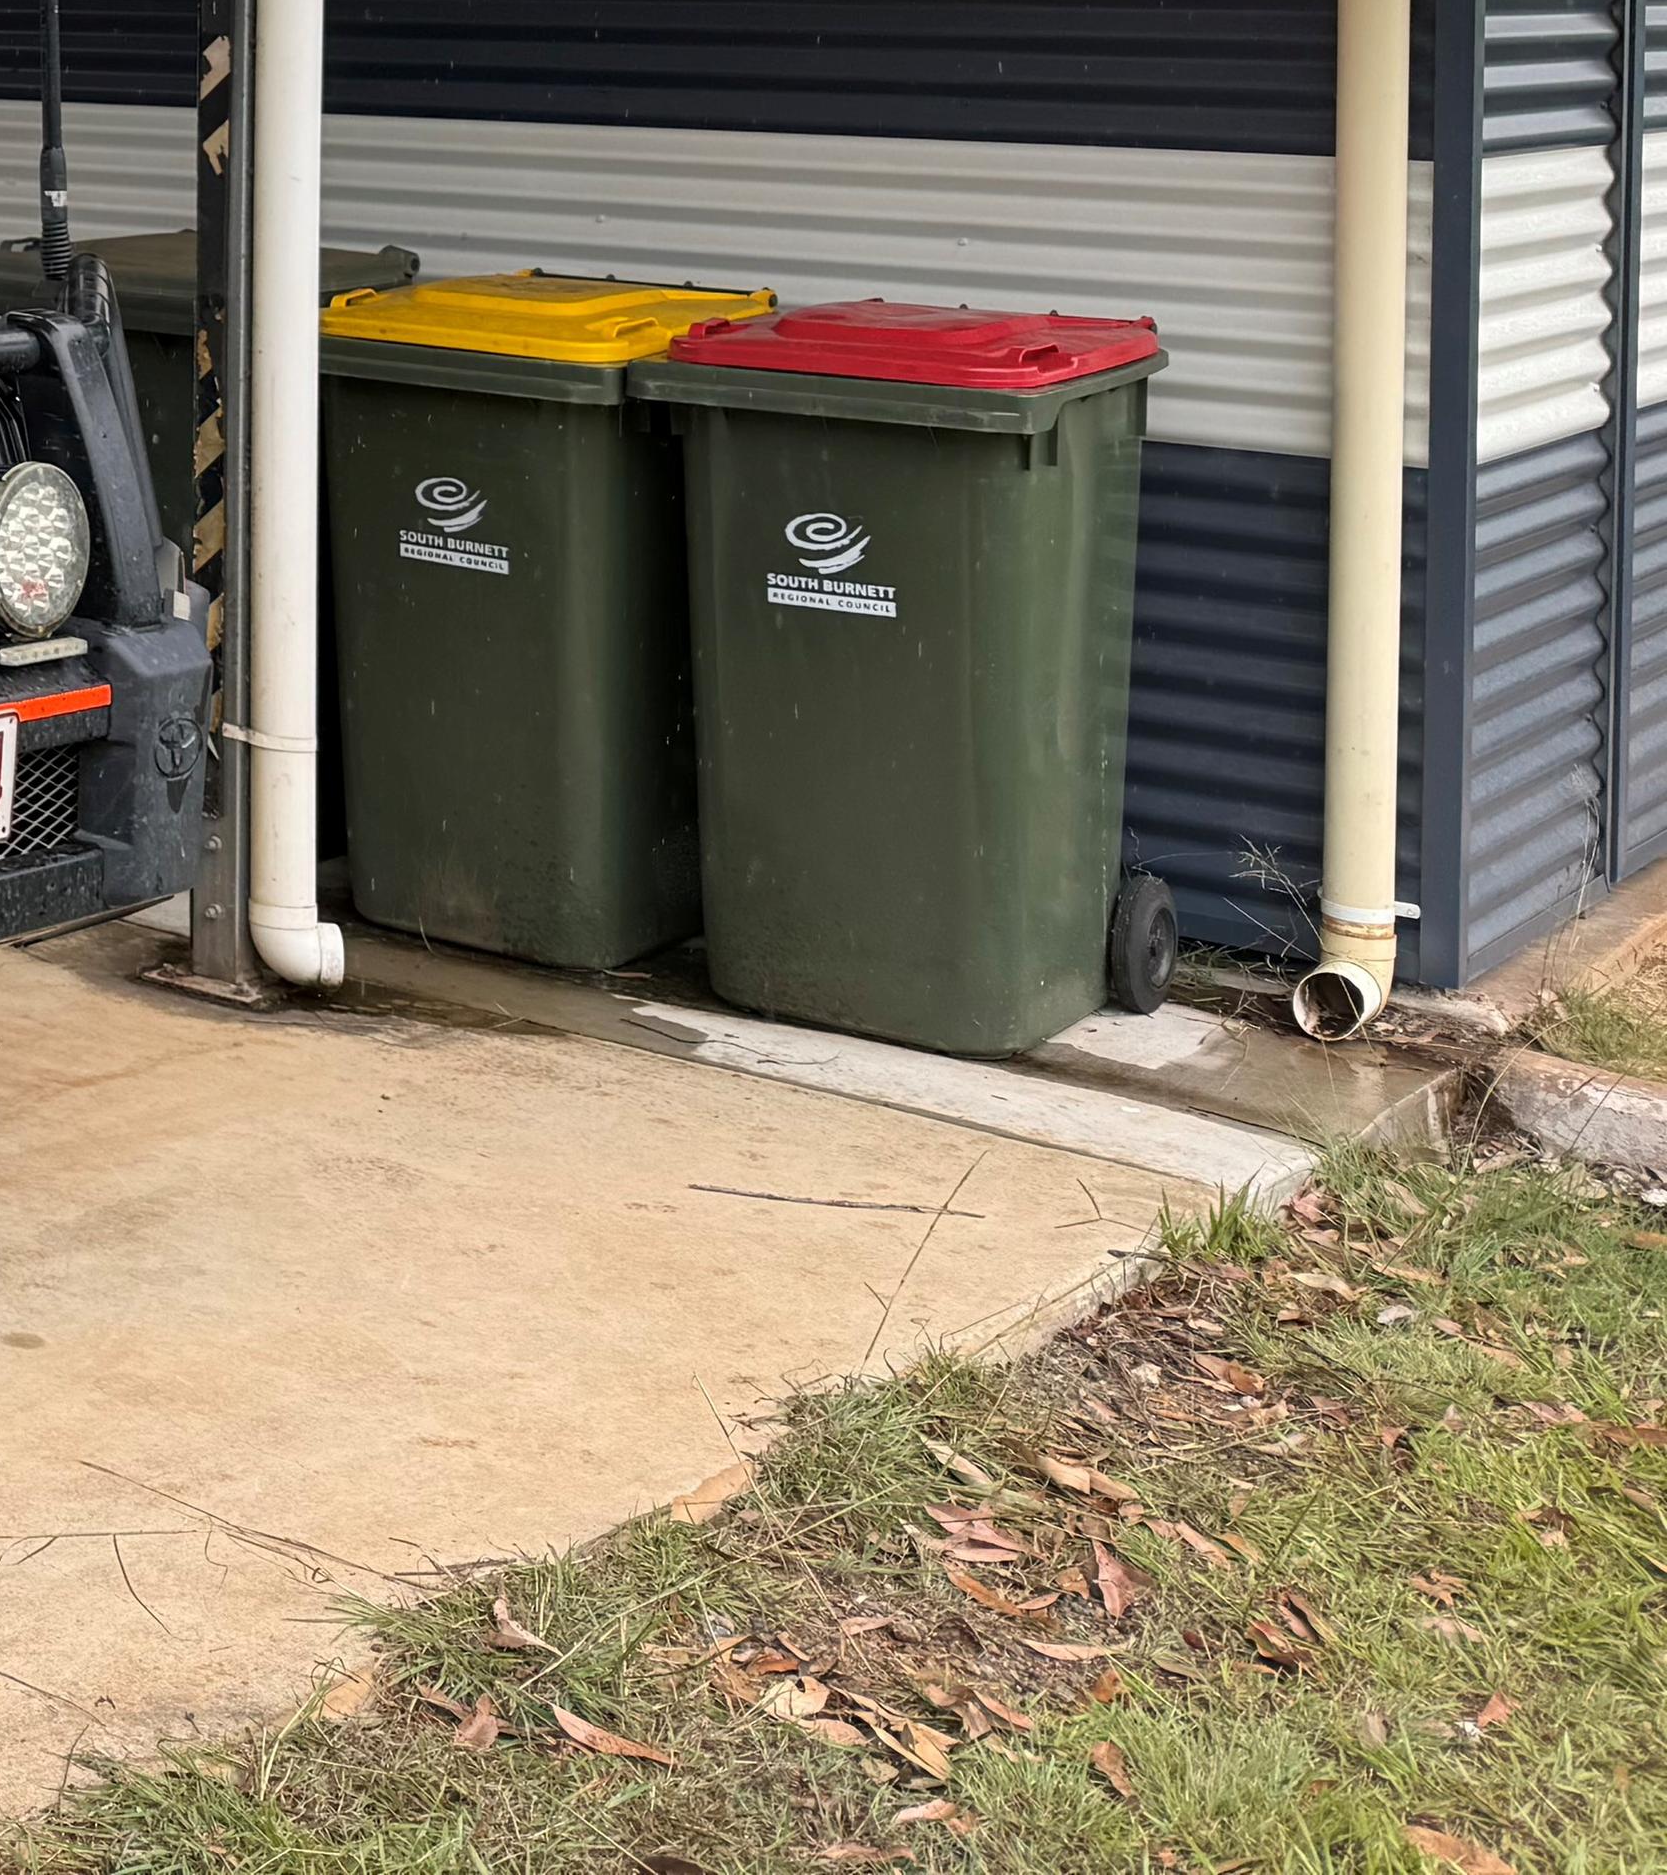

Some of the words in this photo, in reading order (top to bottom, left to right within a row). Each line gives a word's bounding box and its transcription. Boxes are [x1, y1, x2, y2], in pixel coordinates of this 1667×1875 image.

[399, 529, 444, 547] SOUTH
[447, 537, 510, 558] BURNETT
[459, 554, 505, 570] COUNCIL
[766, 572, 819, 590] SOUTH
[822, 579, 897, 599] BURNETT
[772, 591, 831, 606] REGIONAL
[837, 599, 890, 613] COUNCIL
